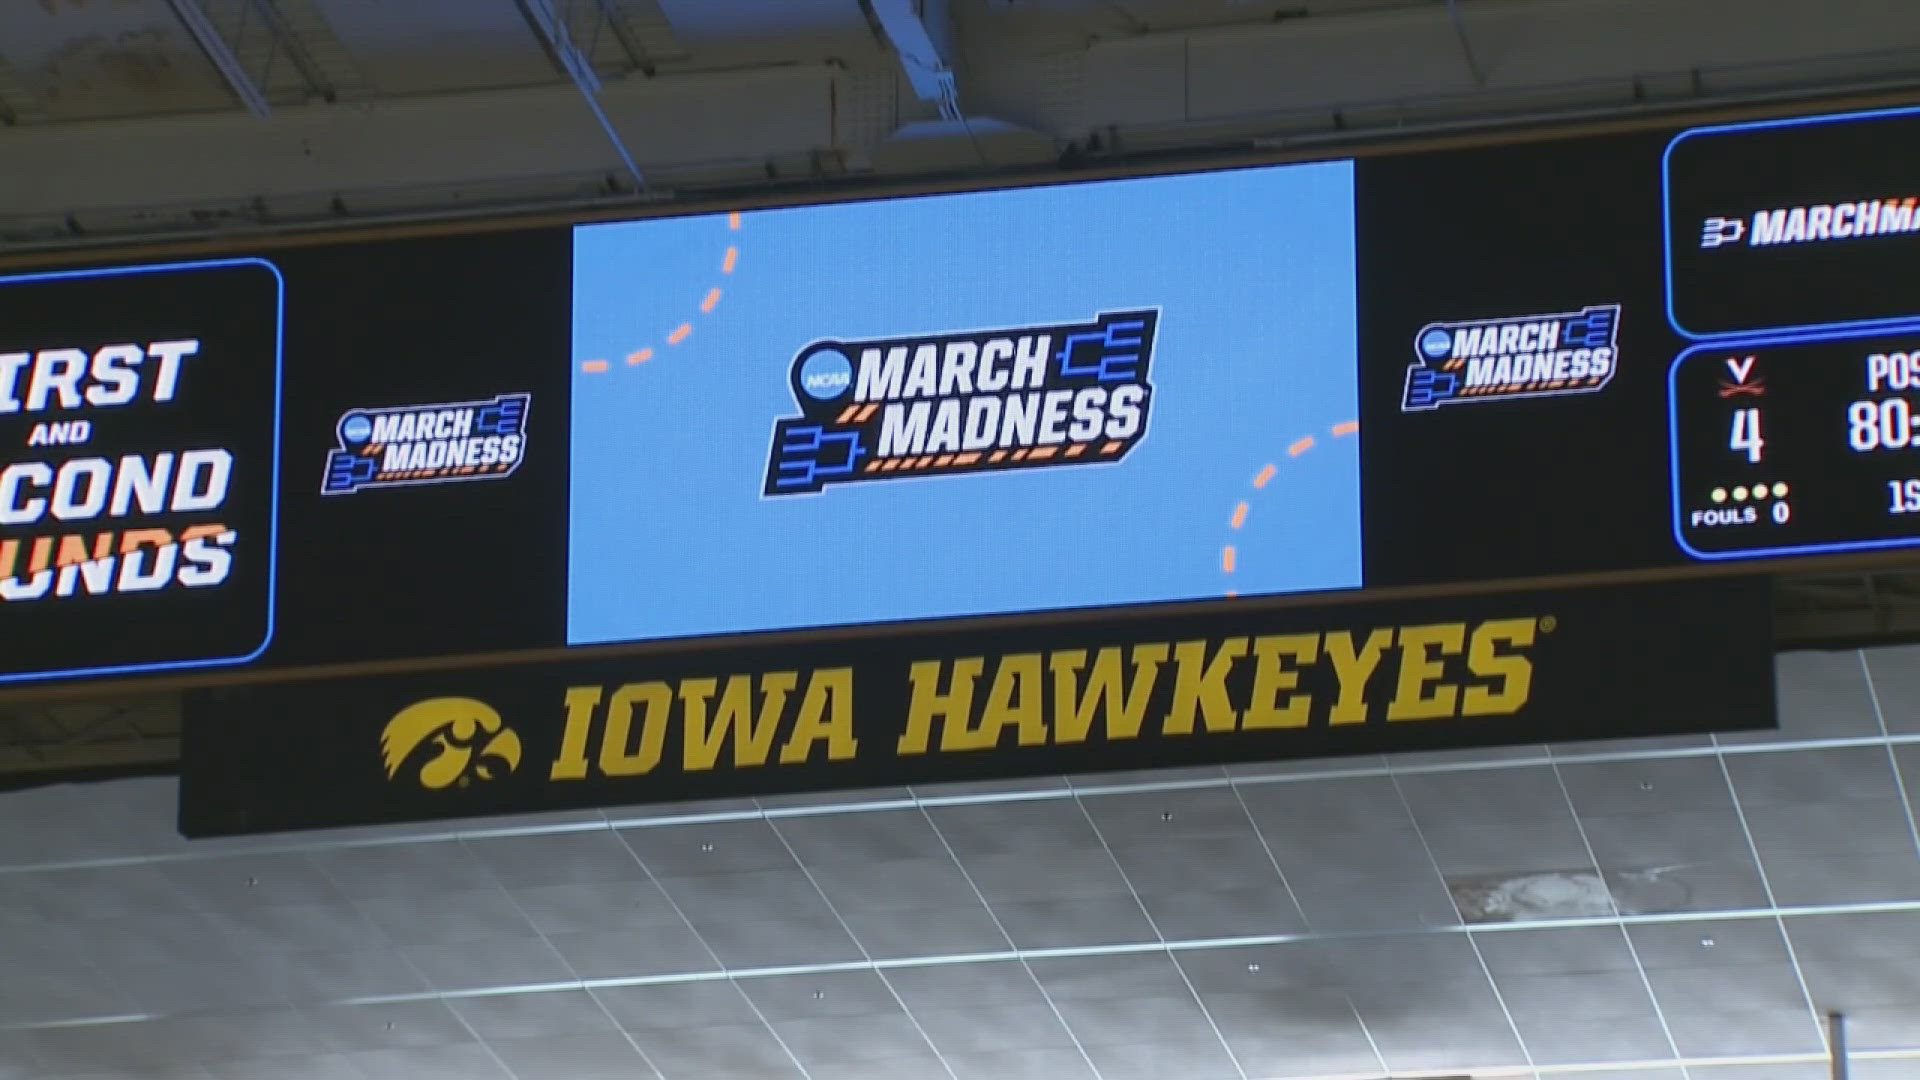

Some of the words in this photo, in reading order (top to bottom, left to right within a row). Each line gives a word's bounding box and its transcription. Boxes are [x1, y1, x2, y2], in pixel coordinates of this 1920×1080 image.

[1452, 321, 1561, 358] MARCH
[854, 334, 1052, 402] MARCH
[1465, 347, 1612, 387] MADNESS
[28, 420, 91, 447] AND
[371, 408, 475, 444] MARCH
[877, 383, 1144, 457] MADNESS
[1730, 407, 1764, 463] 4
[1848, 397, 1920, 452] 80:
[382, 434, 521, 472] MADNESS
[0, 448, 233, 525] COND
[1691, 506, 1757, 527] FOULS
[1772, 501, 1790, 524] 0
[550, 666, 858, 781] IOWA
[897, 617, 1537, 756] HAWKEYES
